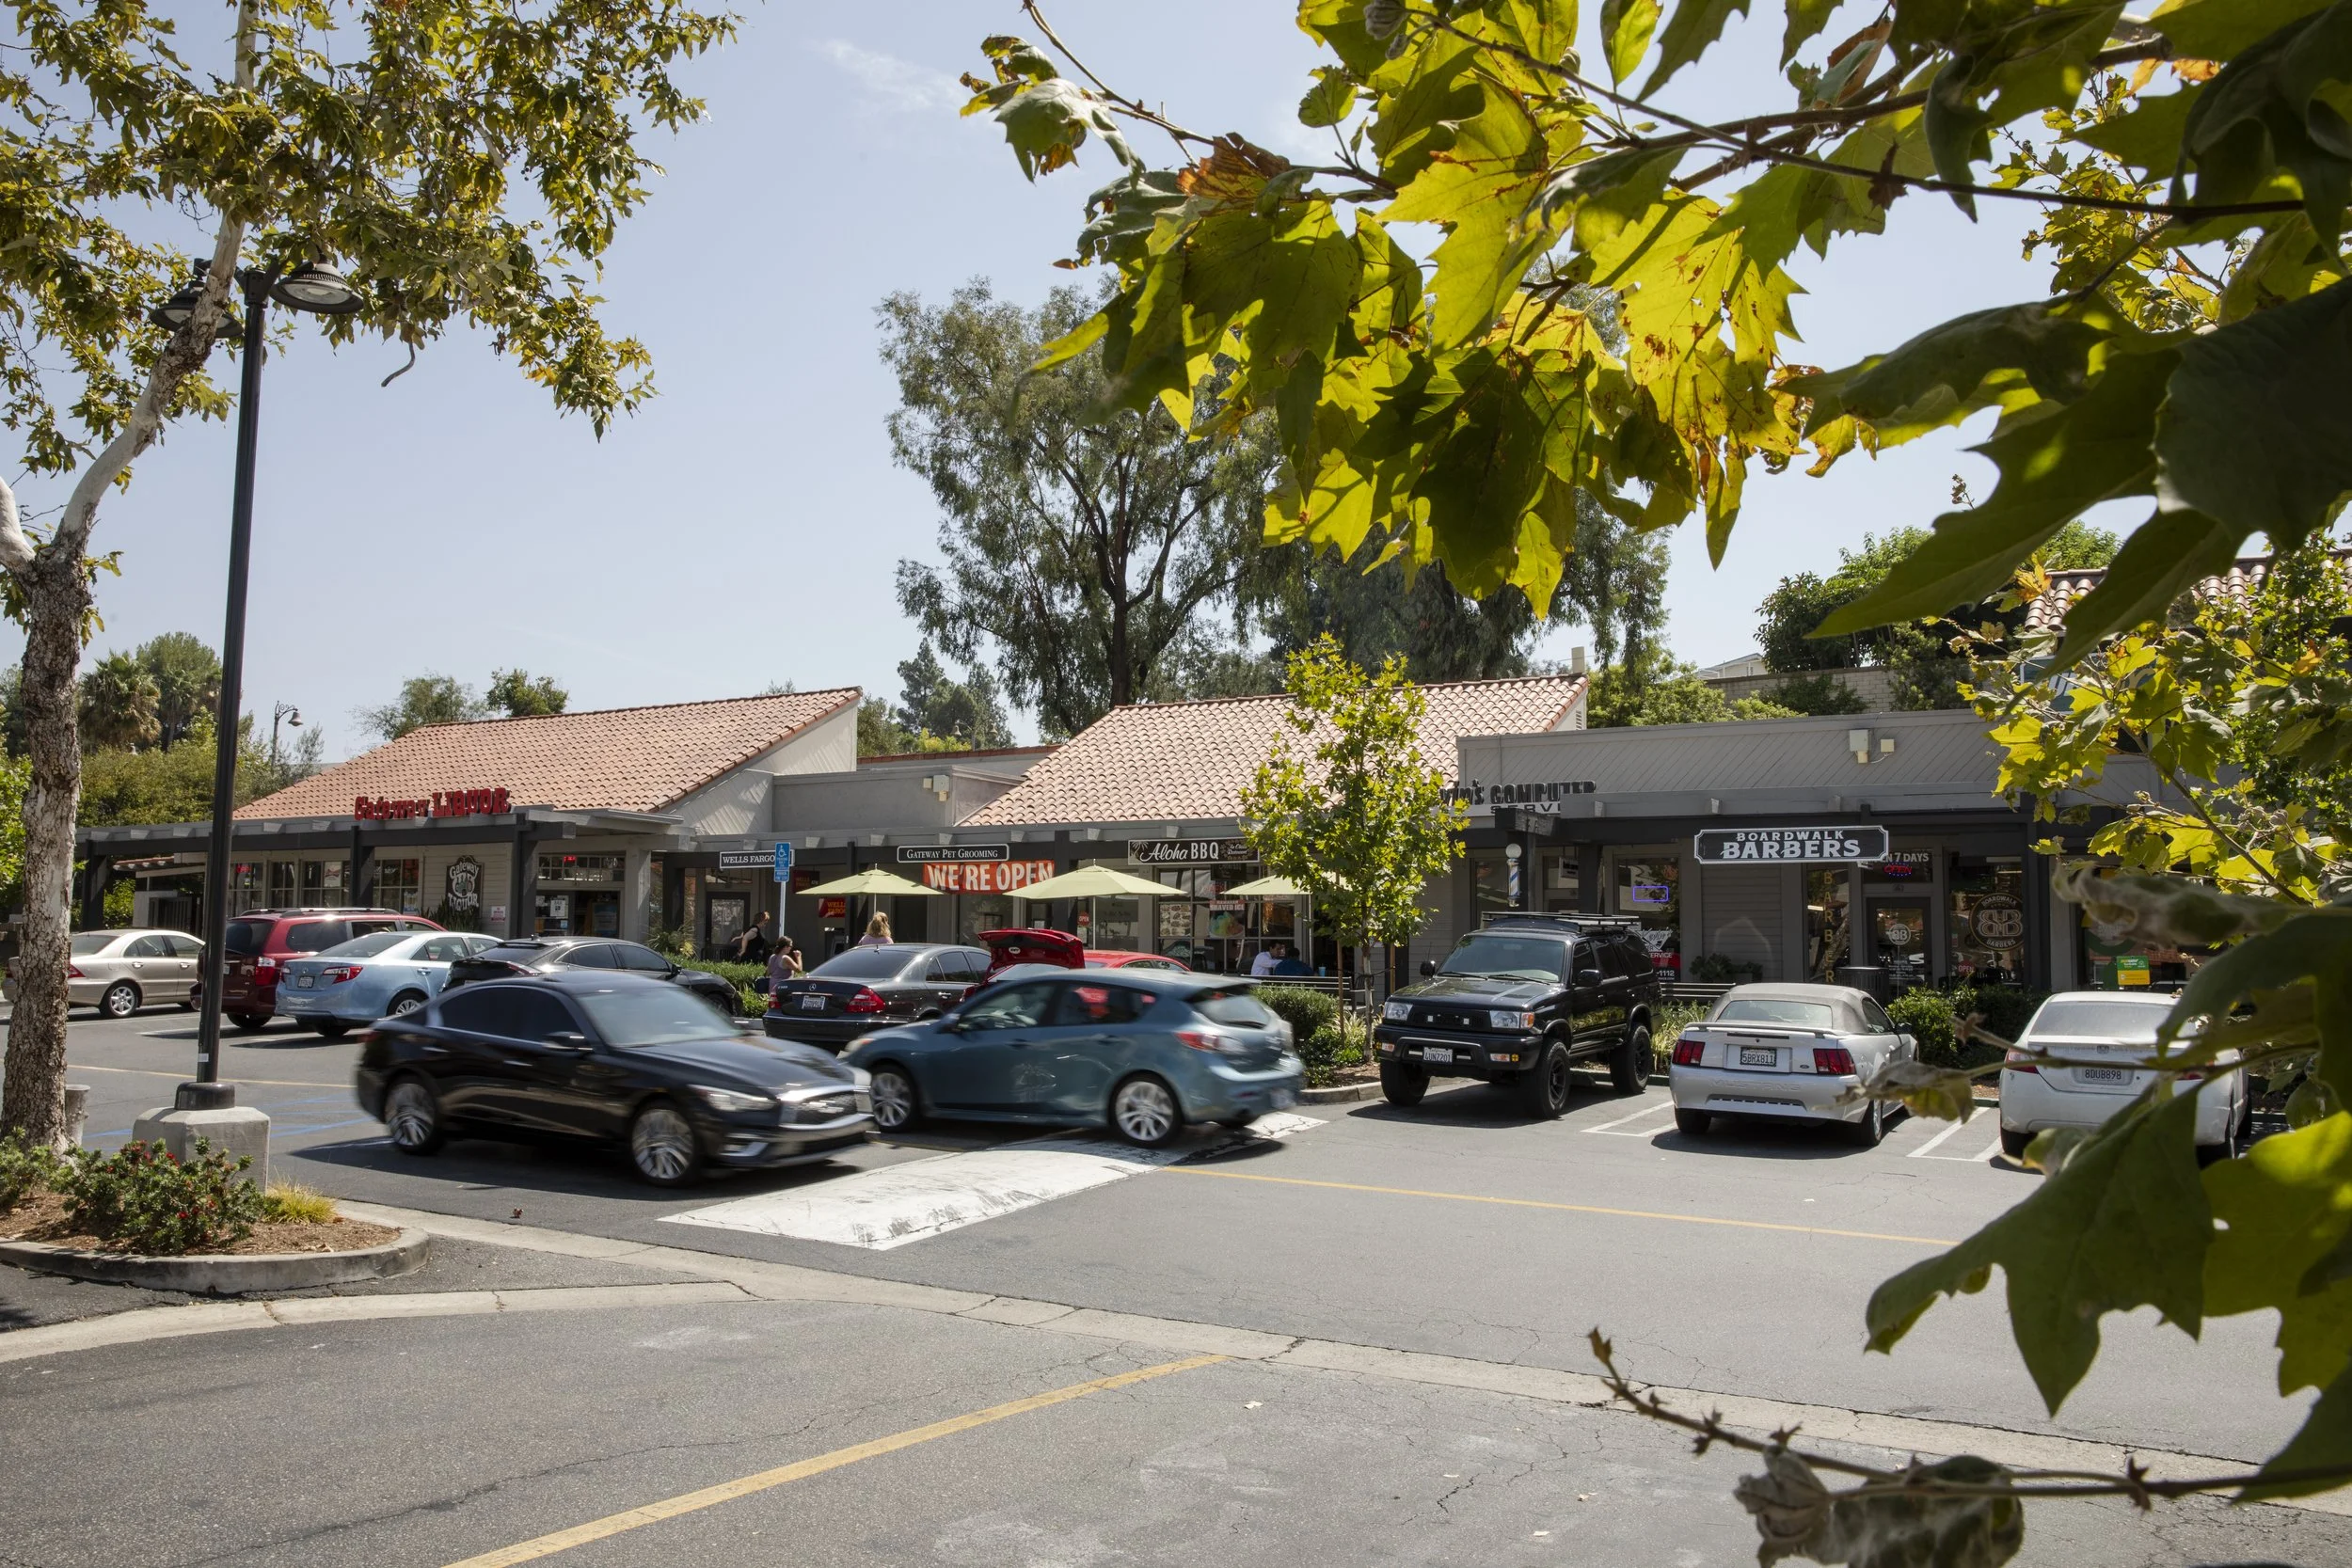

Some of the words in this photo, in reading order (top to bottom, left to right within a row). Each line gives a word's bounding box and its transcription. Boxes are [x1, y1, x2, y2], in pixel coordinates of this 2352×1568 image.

[1490, 781, 1597, 804] COMPUTER
[354, 796, 430, 820] Gateway
[432, 787, 511, 817] LIQUOR
[1737, 830, 1844, 842] BOARDWALK
[906, 849, 940, 859] GATEWAY
[942, 848, 957, 858] PET
[958, 848, 998, 858] GROOMING
[1139, 843, 1188, 862] Aloha
[1190, 841, 1219, 860] BBQ
[1721, 839, 1861, 859] BARBERS
[723, 855, 749, 863] WELLS
[750, 854, 776, 863] FARGO
[1895, 852, 1901, 863] 7
[1903, 852, 1930, 863] DAYS
[450, 862, 480, 879] Gateway
[1883, 863, 1913, 874] OPEN
[927, 863, 991, 891] WE'RE
[995, 862, 1054, 891] OPEN
[448, 893, 480, 911] LIQUOR
[1980, 895, 2017, 907] BOARDWALK
[1986, 939, 2016, 948] BARBERS
[1742, 1053, 1774, 1064] 5BRX811
